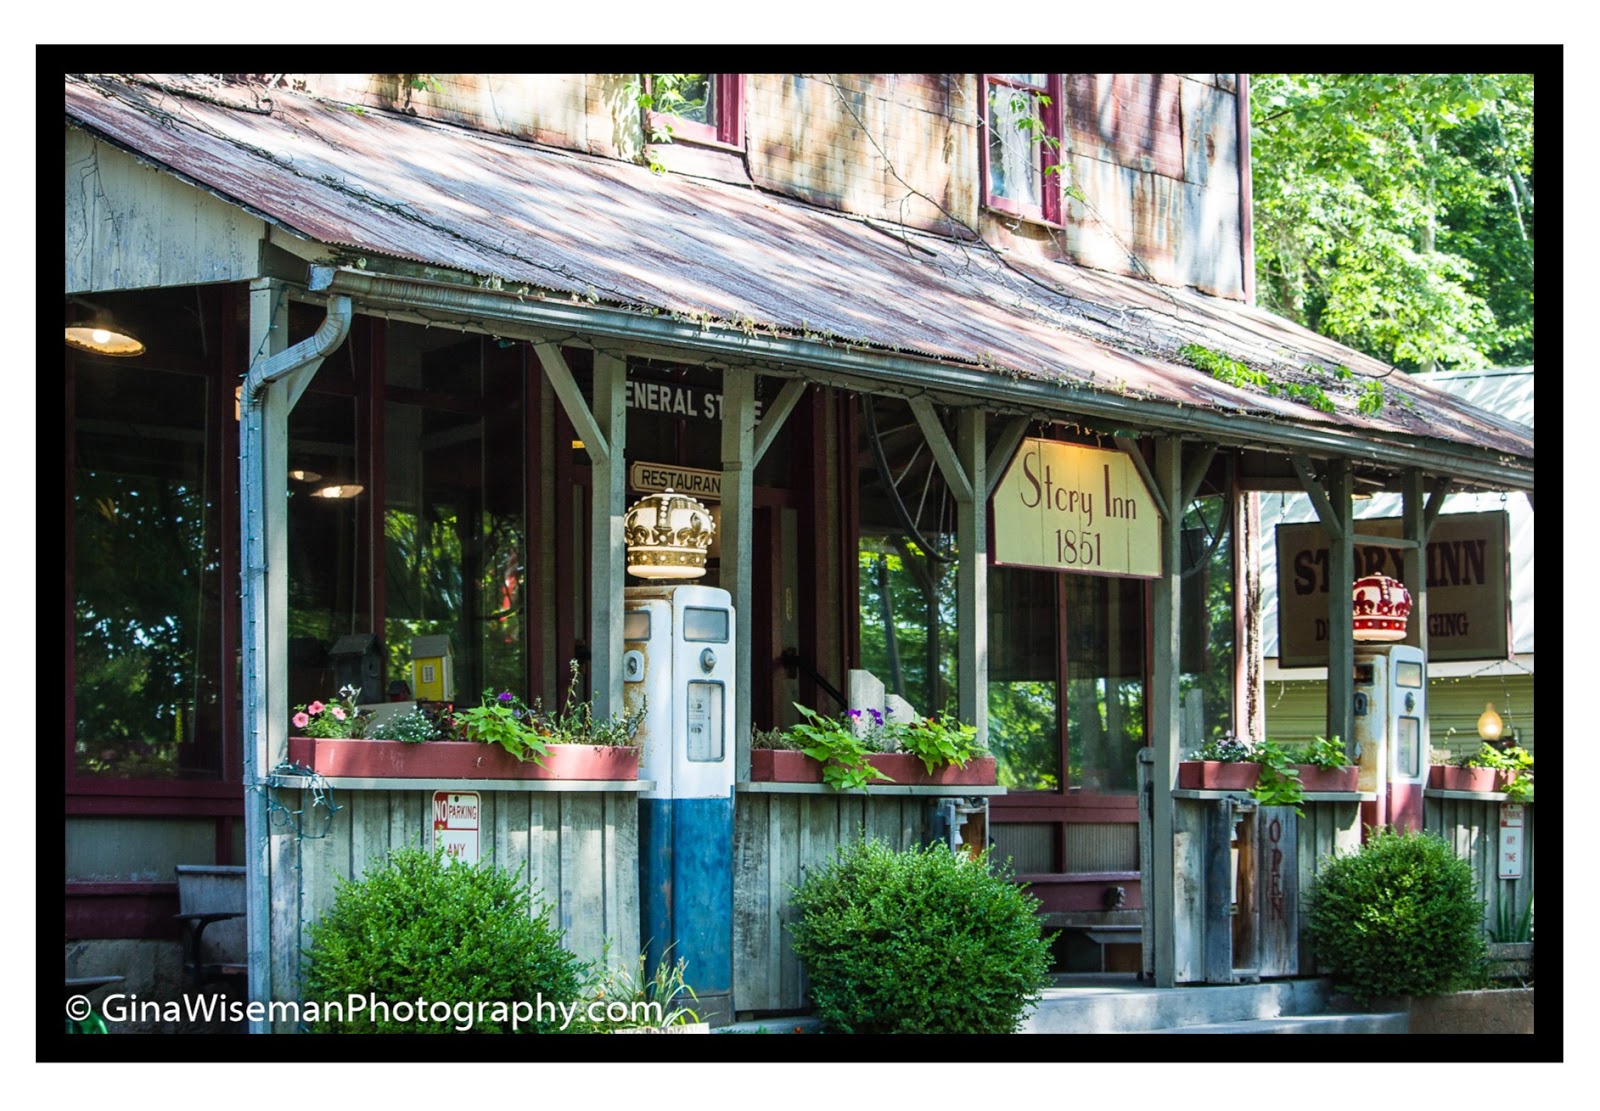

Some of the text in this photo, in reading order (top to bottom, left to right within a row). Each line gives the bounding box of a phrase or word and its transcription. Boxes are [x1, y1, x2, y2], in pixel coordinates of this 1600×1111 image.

[625, 381, 762, 426] ENERAL STE
[642, 469, 721, 493] RESTAURAN
[1104, 464, 1137, 520] Inn
[1055, 529, 1101, 566] 1851
[1428, 612, 1469, 637] GING
[434, 800, 477, 822] NO PARKING
[447, 843, 466, 857] ANY
[1269, 819, 1283, 921] OPEN
